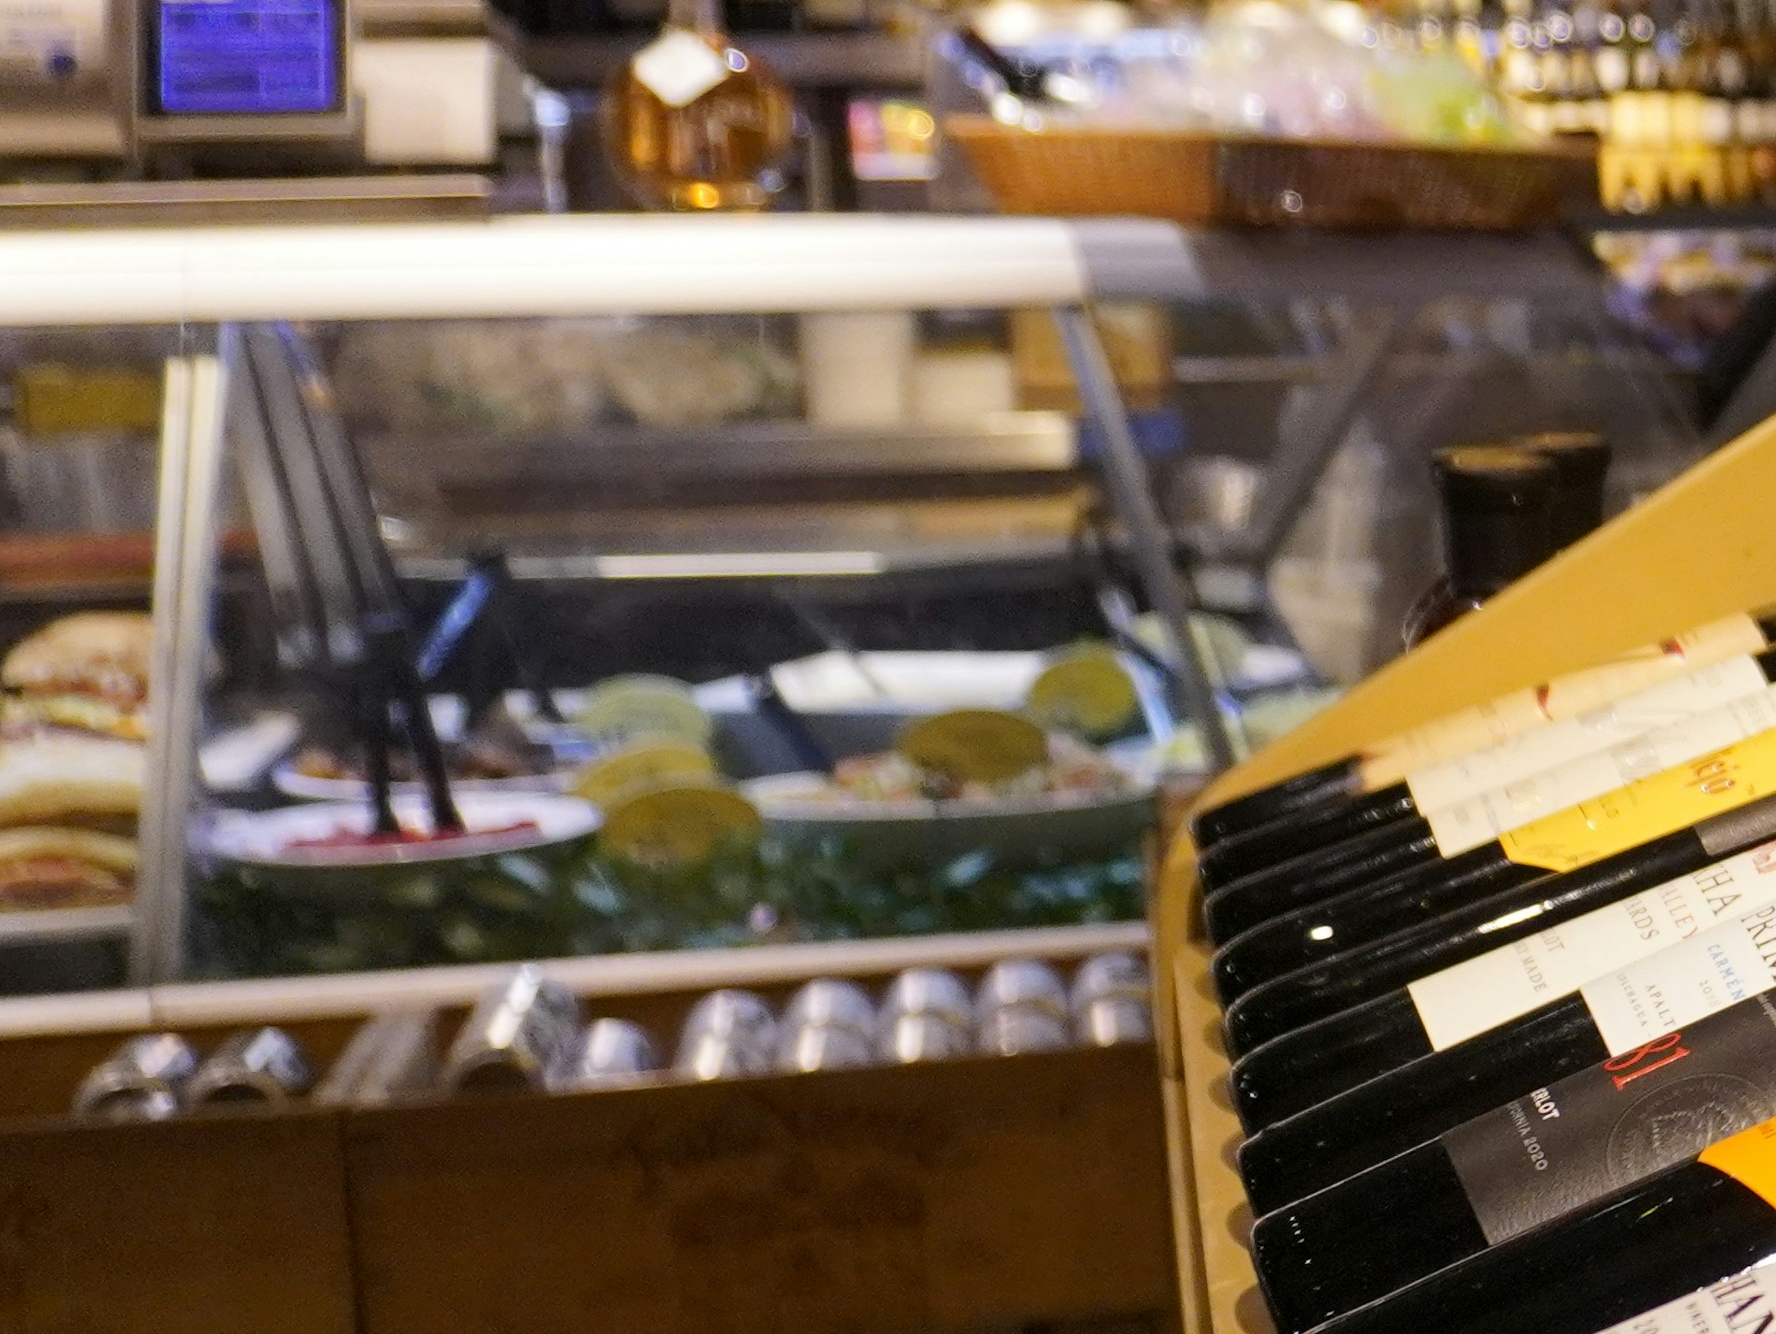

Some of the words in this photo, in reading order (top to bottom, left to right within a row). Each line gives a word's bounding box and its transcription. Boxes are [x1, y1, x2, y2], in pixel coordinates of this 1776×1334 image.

[1706, 943, 1746, 1002] CARMÉN
[1645, 984, 1676, 1027] APALT
[1529, 1086, 1560, 1122] ERLOT
[1522, 1135, 1549, 1171] 2020
